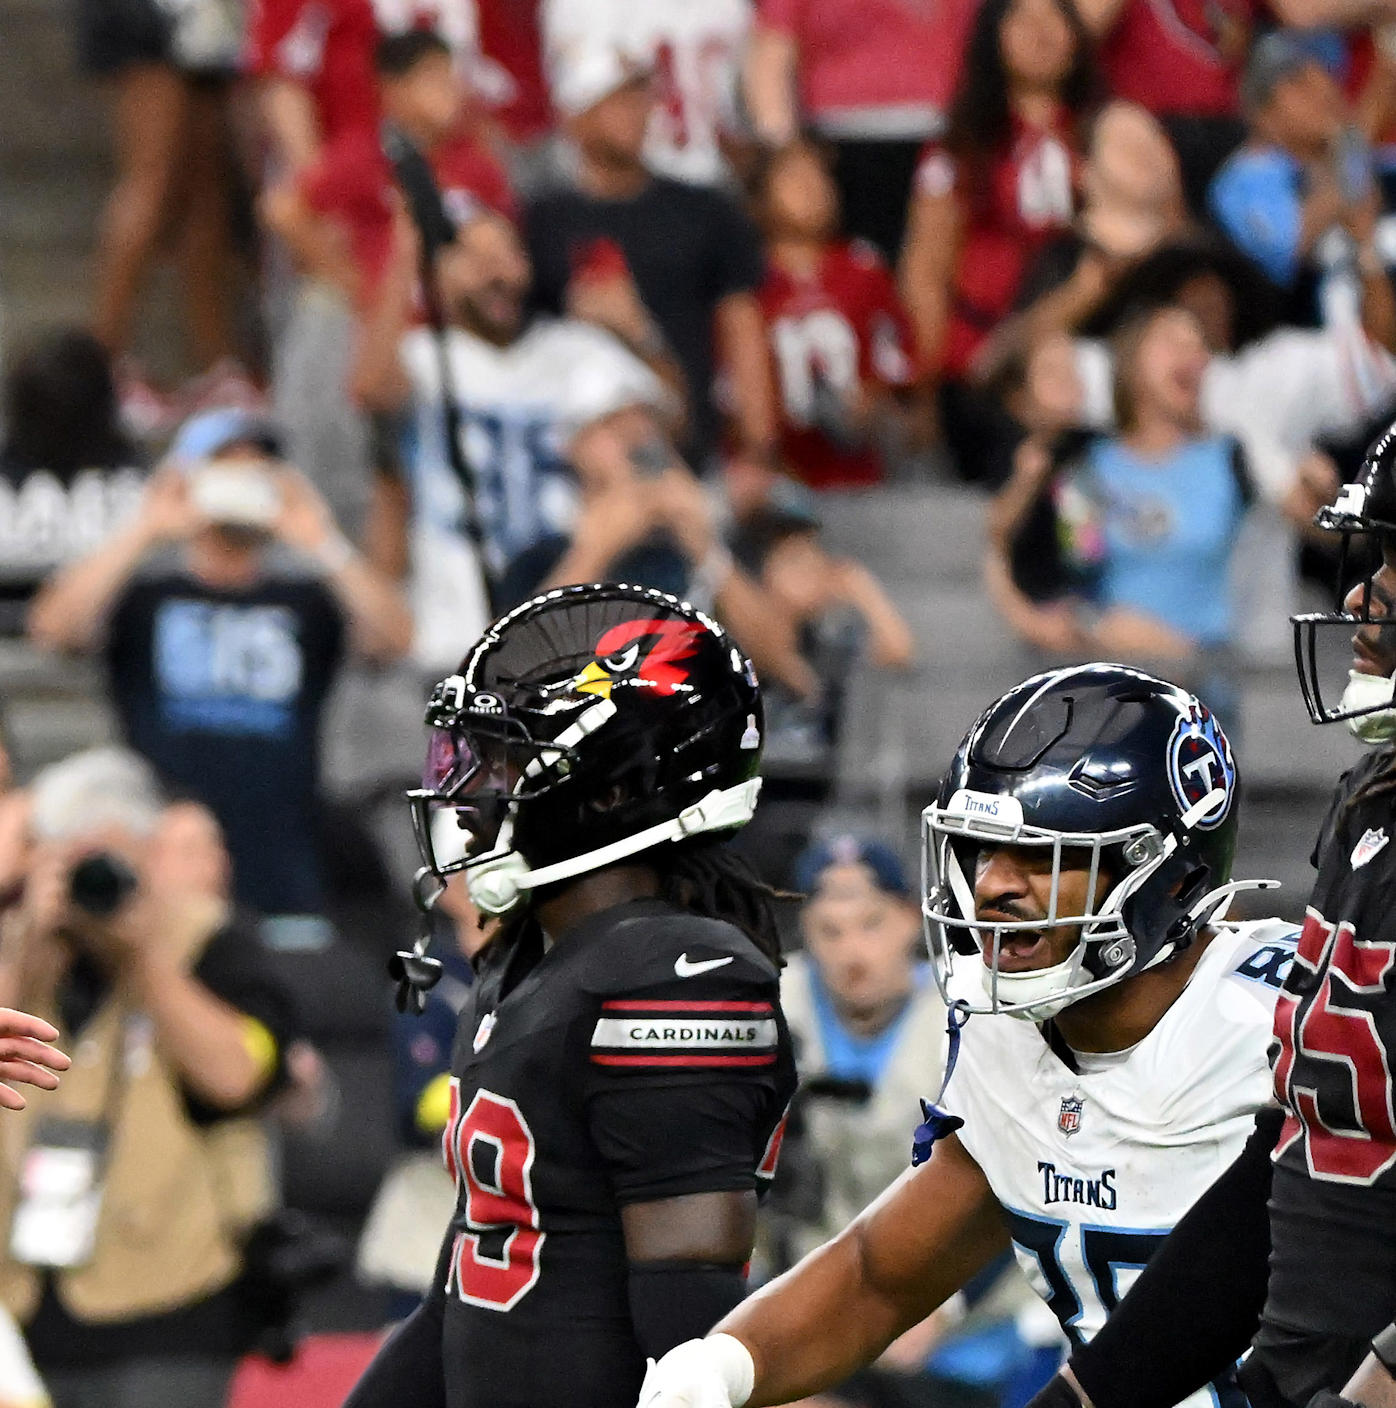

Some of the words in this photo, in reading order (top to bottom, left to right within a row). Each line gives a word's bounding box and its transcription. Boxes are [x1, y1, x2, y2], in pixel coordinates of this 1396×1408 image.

[965, 794, 1000, 816] TITANS
[630, 1026, 757, 1042] CARDINALS
[1037, 1160, 1117, 1211] TITANS
